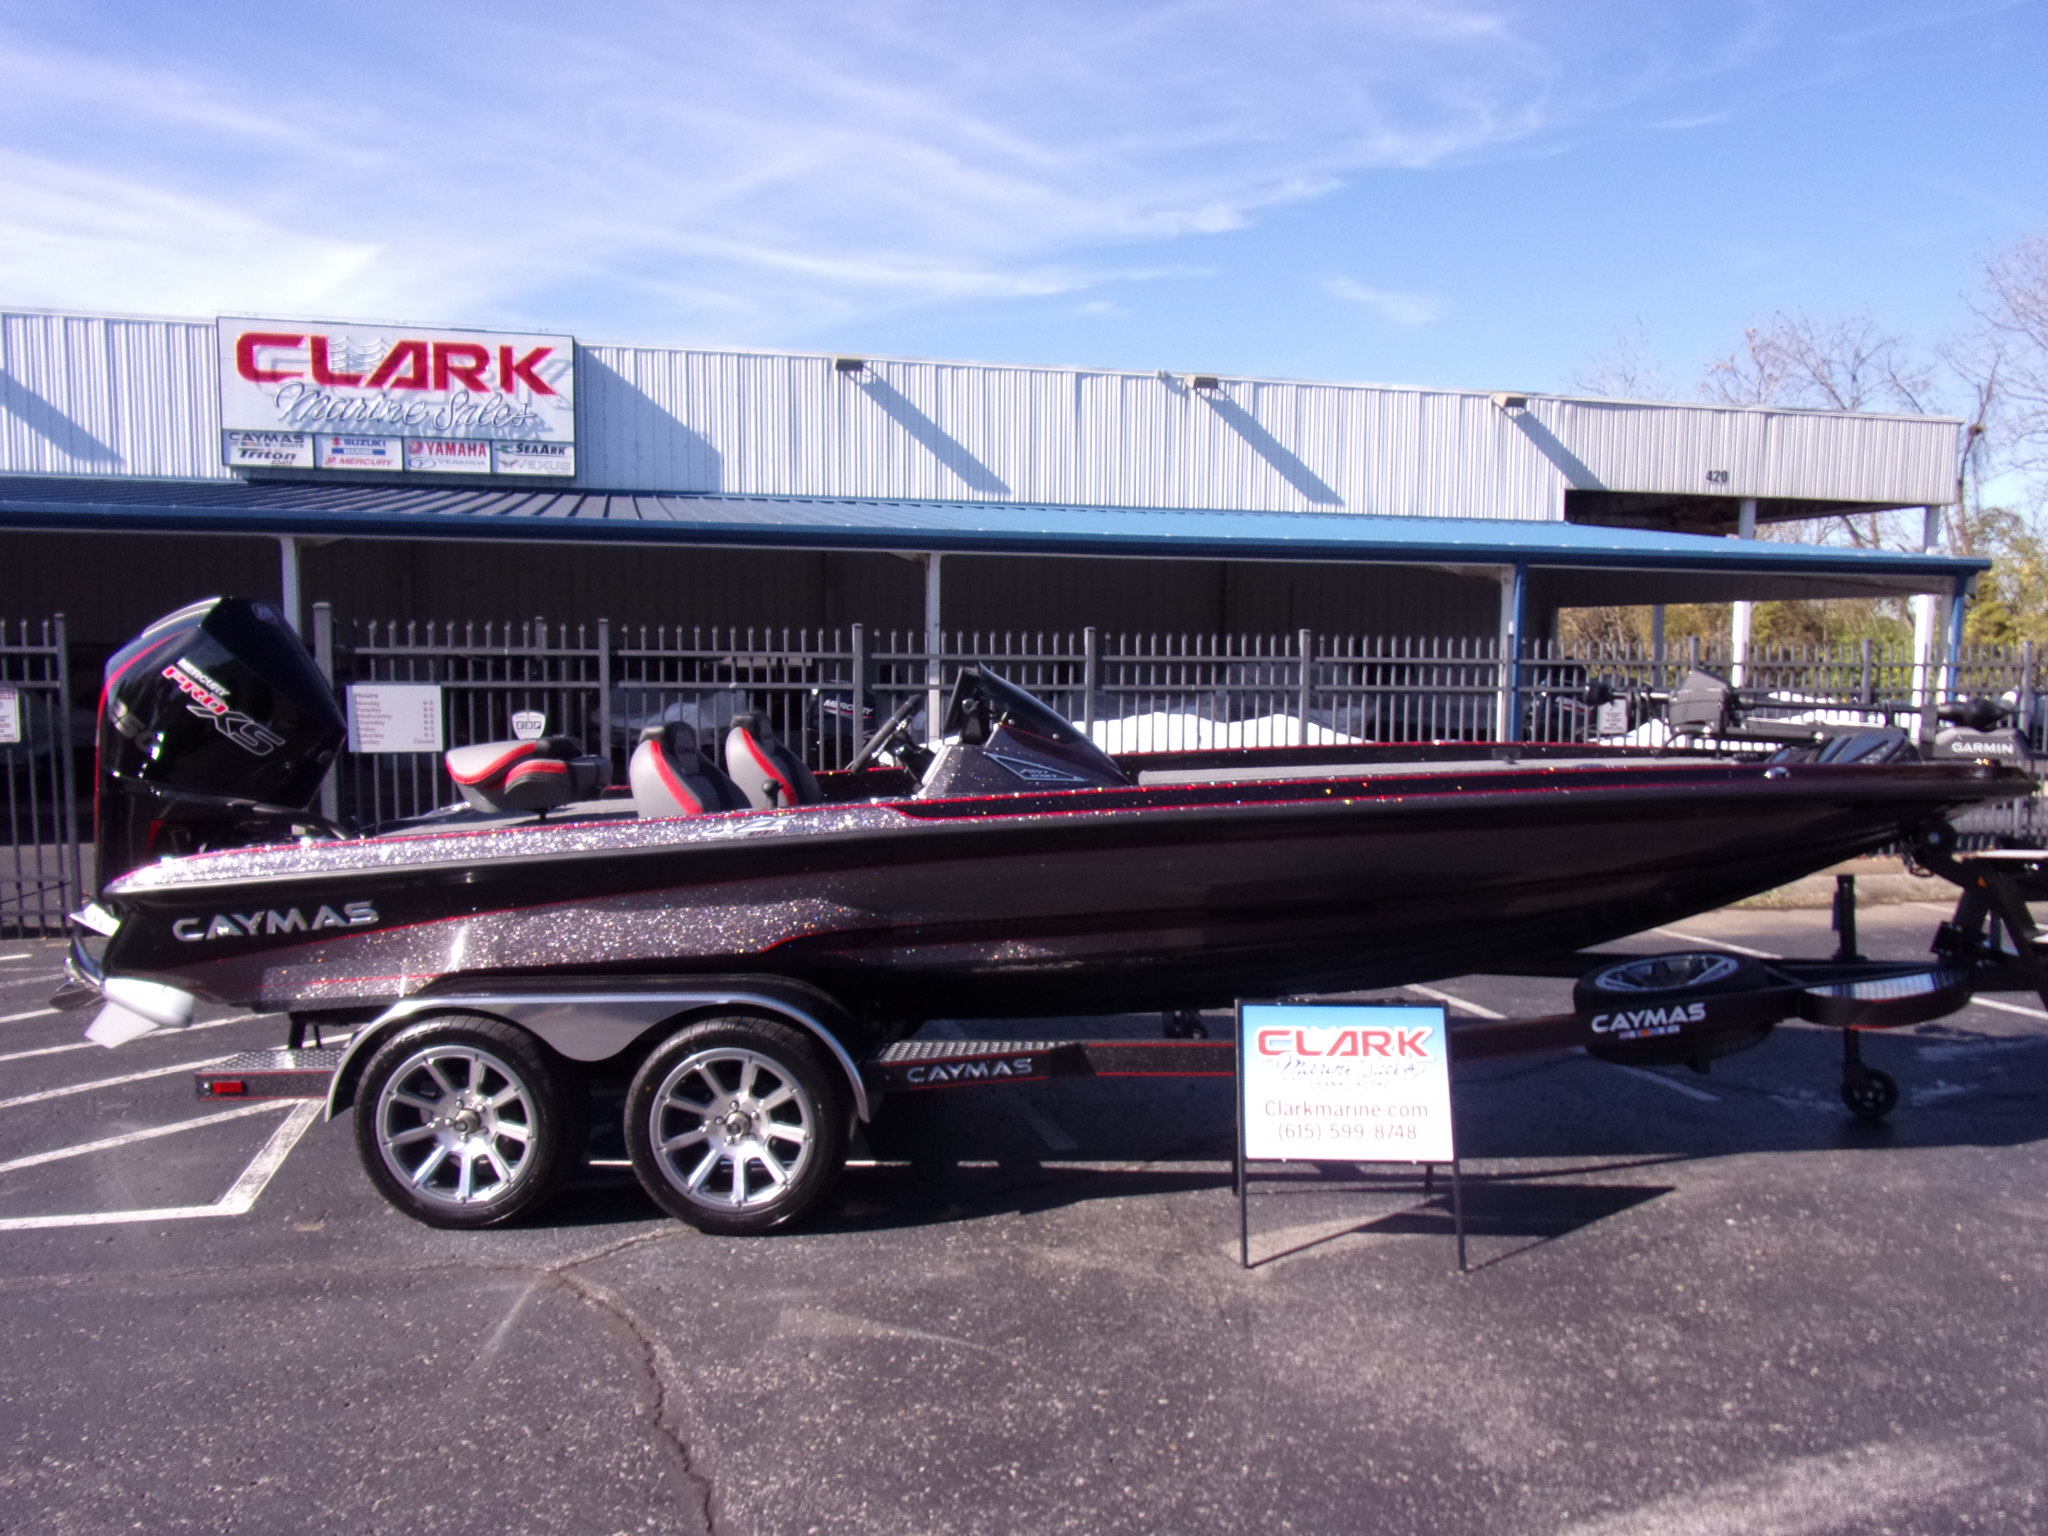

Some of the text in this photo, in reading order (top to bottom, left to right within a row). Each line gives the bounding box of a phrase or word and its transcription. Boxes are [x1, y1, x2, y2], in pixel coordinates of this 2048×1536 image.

[236, 331, 558, 396] CLARK
[273, 381, 538, 430] Marine Sales
[229, 432, 305, 443] CAYMAS
[344, 438, 386, 447] SUZUKI
[238, 448, 297, 460] Triton
[426, 441, 487, 457] YAMAHA
[339, 457, 393, 466] MERCURY
[1706, 470, 1728, 483] 420
[176, 658, 231, 697] MERCURY
[161, 665, 229, 715] PRO
[824, 699, 874, 715] MERCRY
[185, 704, 286, 756] XS
[1951, 741, 2014, 755] GARMIN
[172, 900, 379, 942] CAYMAS
[1591, 1002, 1706, 1034] CAYMAS
[1258, 1030, 1428, 1056] CLARK
[907, 1058, 1032, 1083] CAYMAS
[1278, 1123, 1321, 1141] (615)
